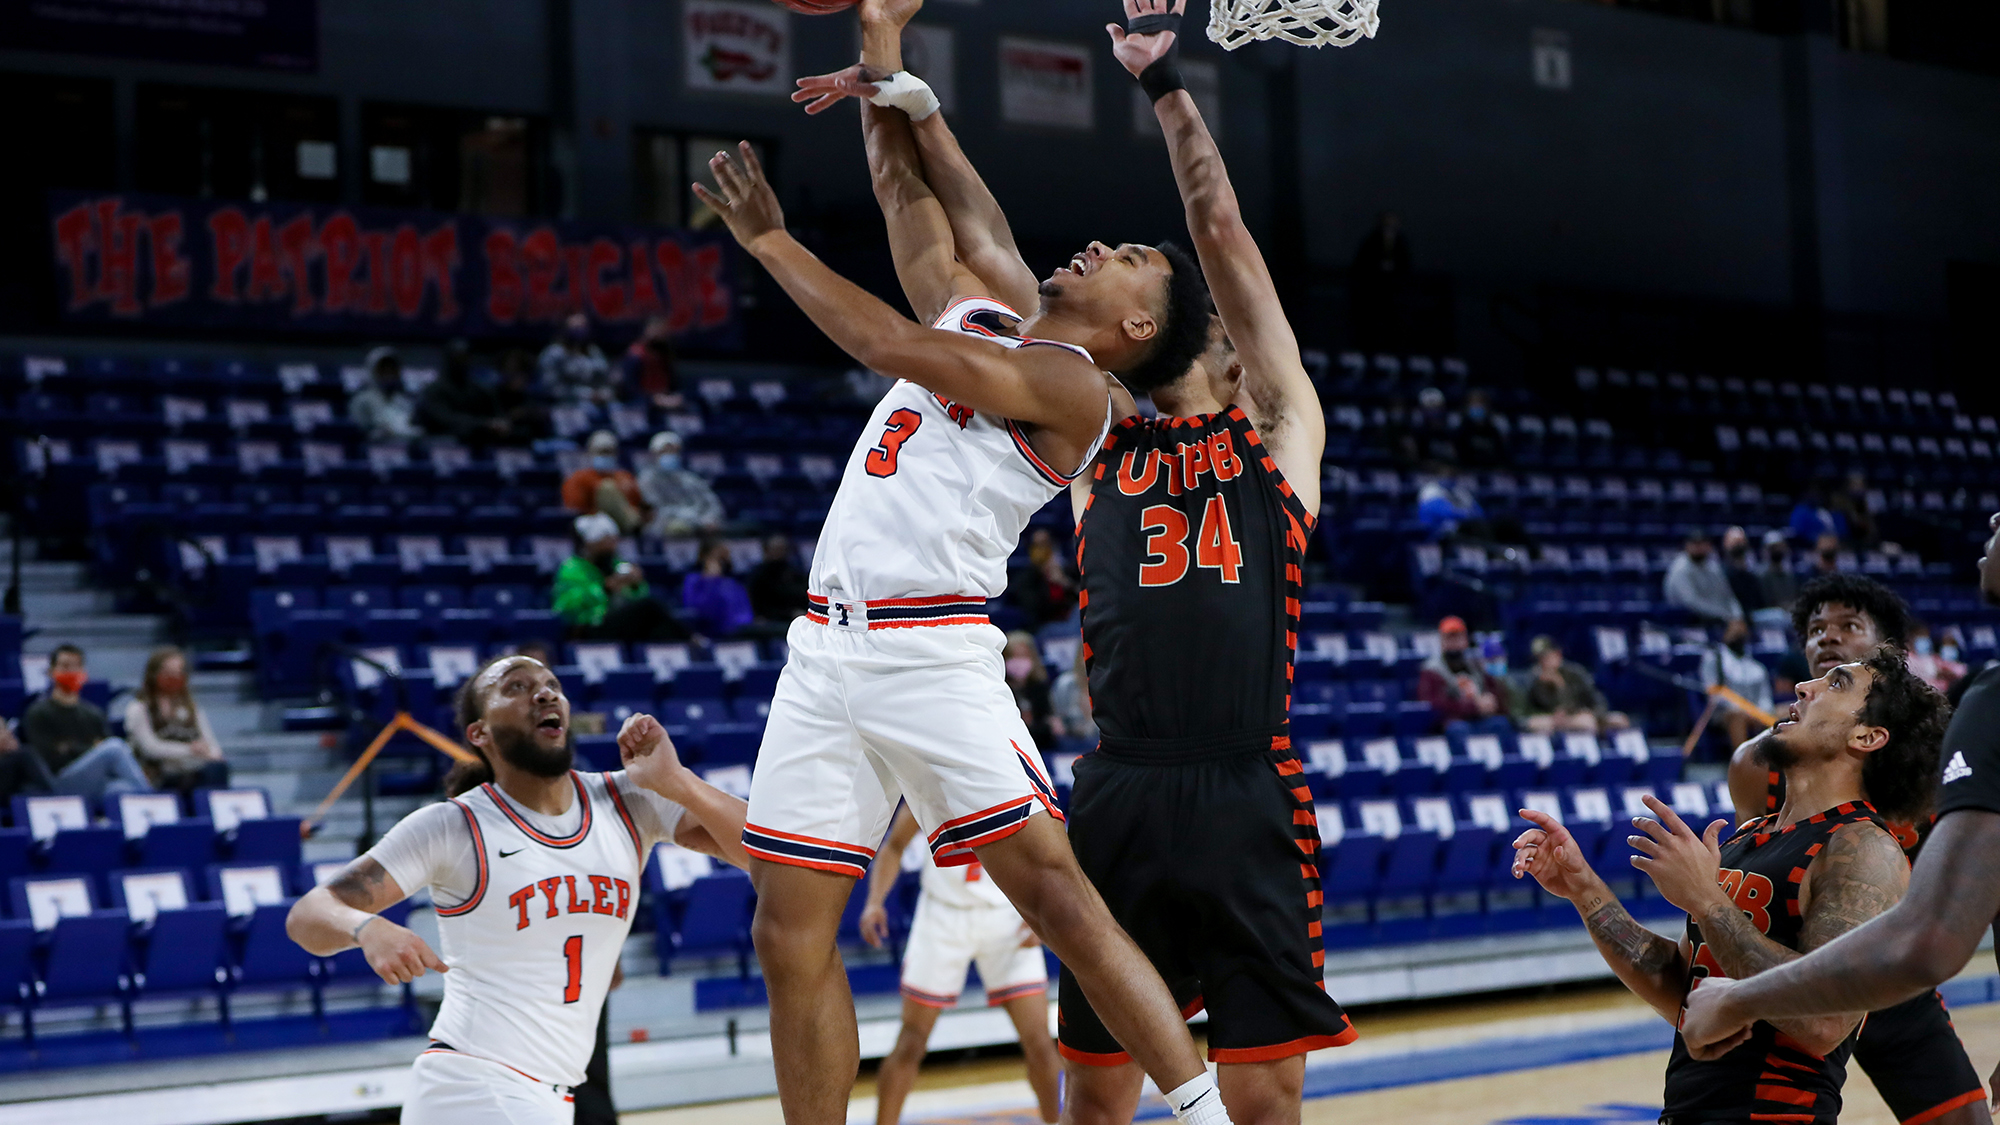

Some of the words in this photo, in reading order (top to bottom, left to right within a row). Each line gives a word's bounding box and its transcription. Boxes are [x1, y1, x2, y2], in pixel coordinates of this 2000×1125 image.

[54, 197, 192, 317] THE
[206, 205, 461, 323] PATRIOT
[484, 228, 730, 333] BRIGADE
[865, 407, 922, 479] 3
[1116, 428, 1243, 496] UTPB
[1139, 492, 1244, 587] 34
[509, 874, 631, 931] TYLER
[564, 934, 583, 1004] 1
